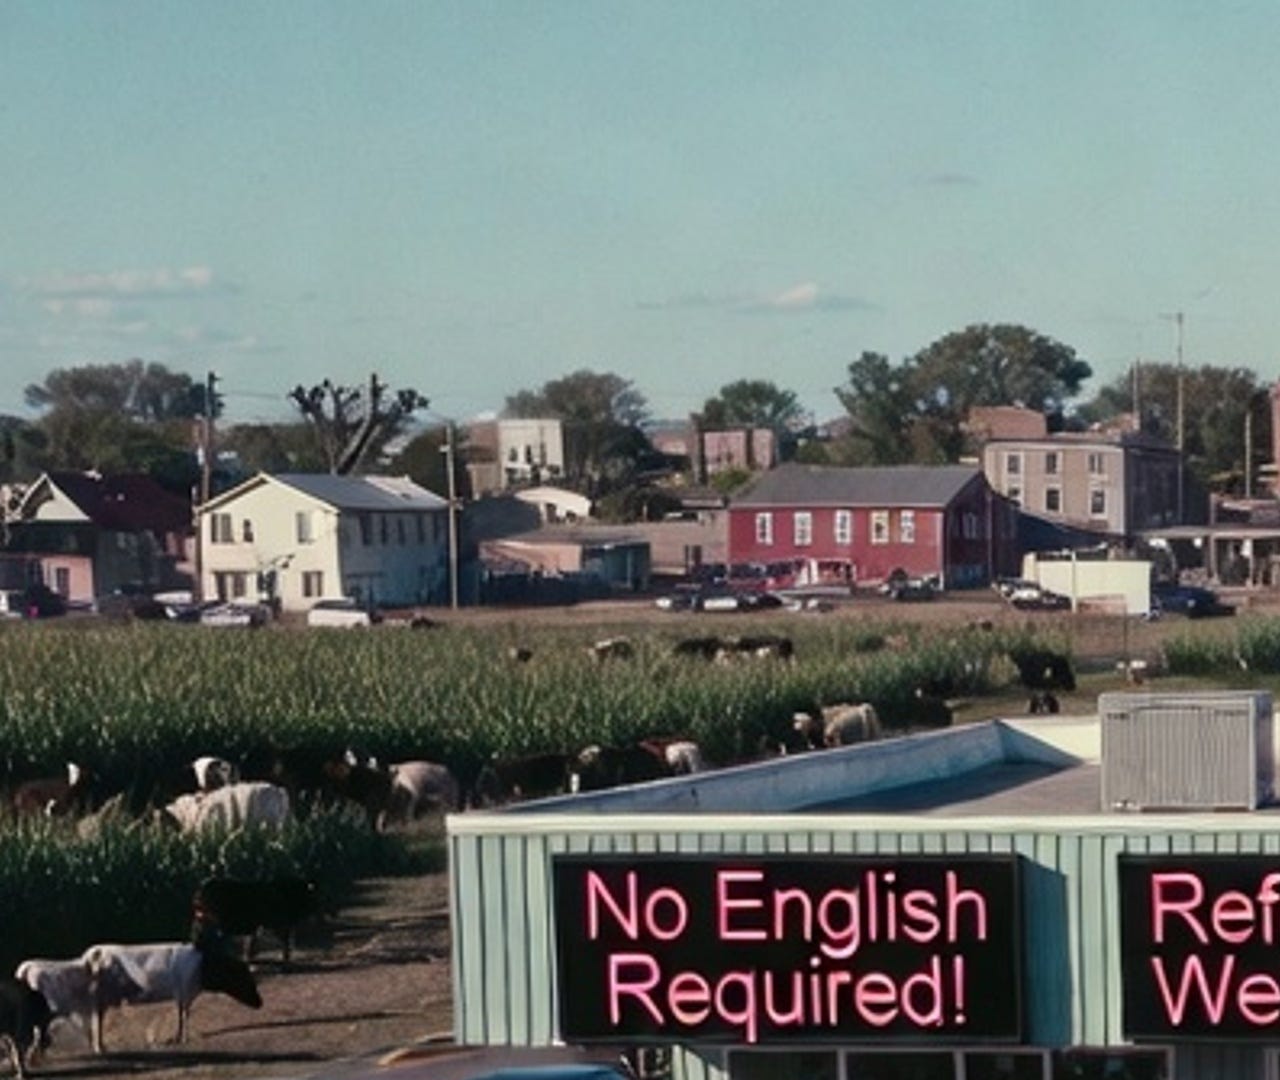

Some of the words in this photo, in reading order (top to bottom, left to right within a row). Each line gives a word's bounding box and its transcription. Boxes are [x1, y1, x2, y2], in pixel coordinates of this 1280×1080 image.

[586, 870, 688, 941] No
[717, 870, 988, 959] English
[608, 952, 967, 1044] Required!
